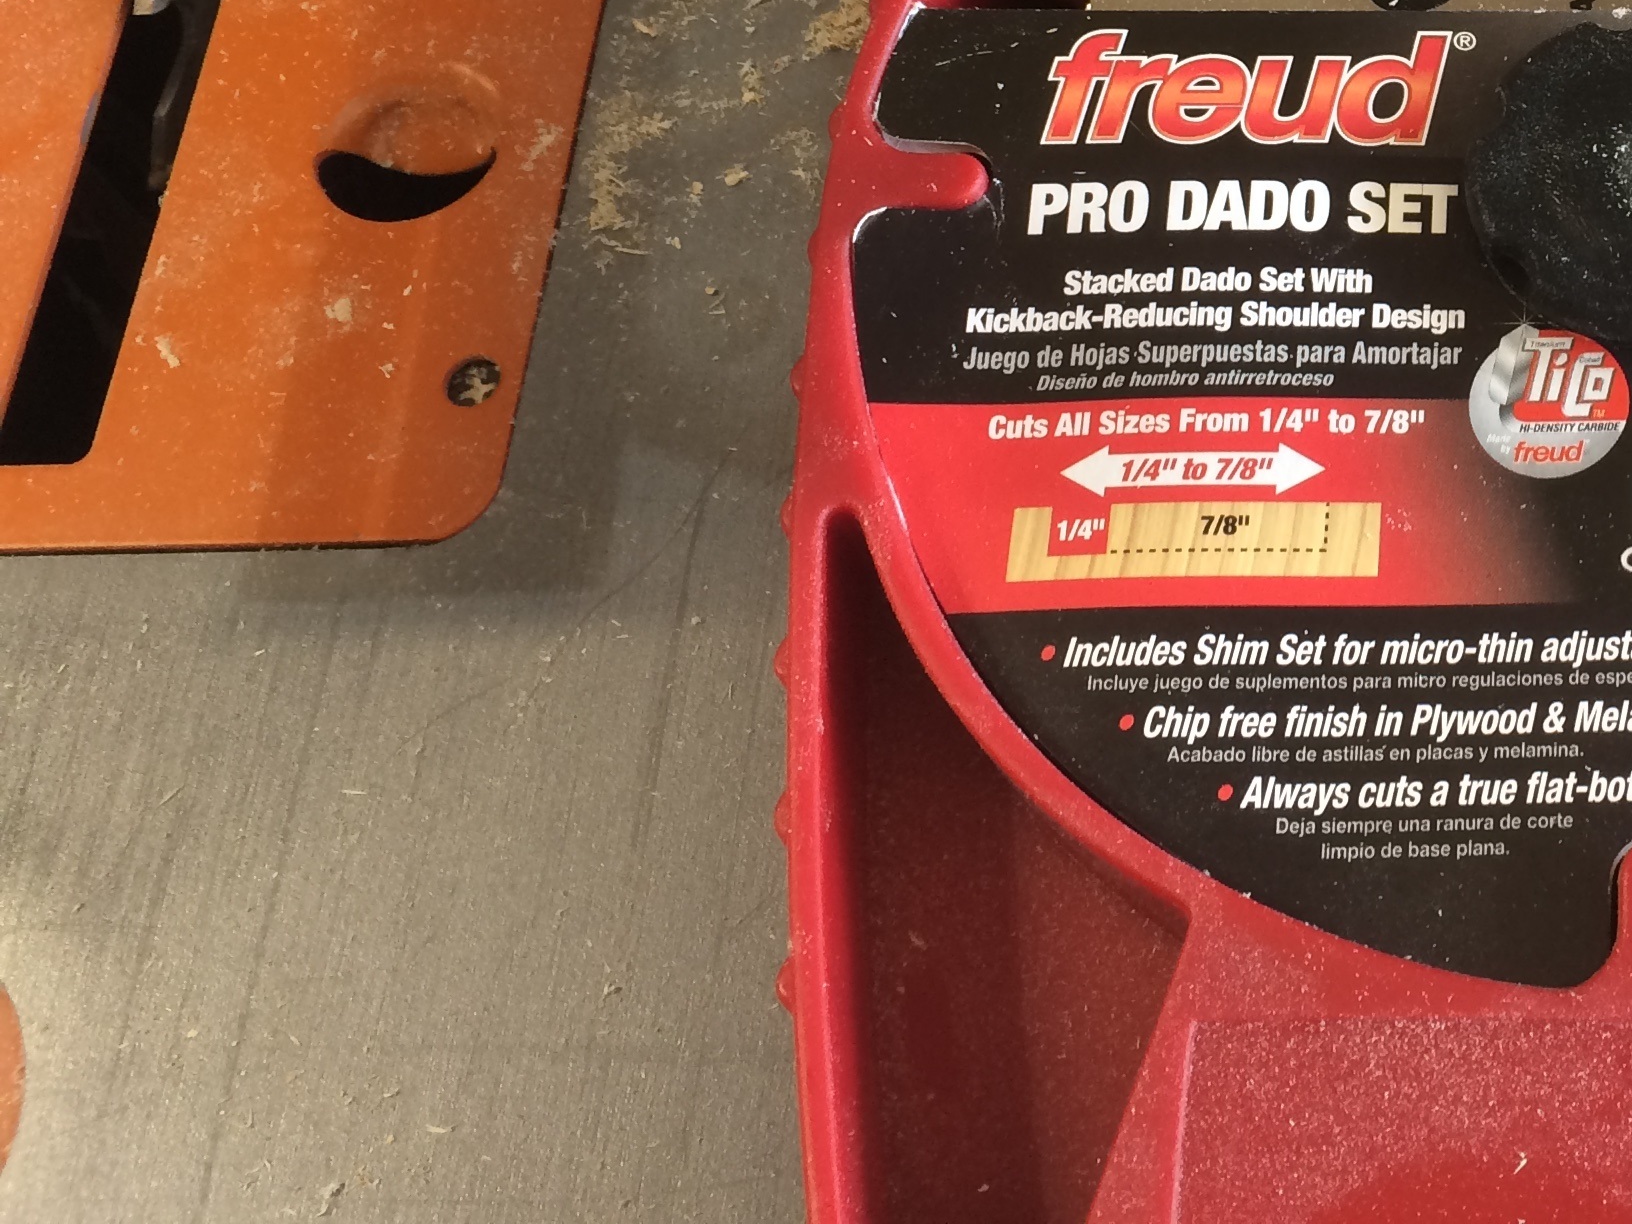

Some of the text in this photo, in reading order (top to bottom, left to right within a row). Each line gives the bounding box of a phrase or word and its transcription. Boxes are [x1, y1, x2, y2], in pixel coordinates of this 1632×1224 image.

[1027, 179, 1459, 236] PRO DADO SET
[1063, 267, 1373, 296] Stacked Dado Set With
[965, 301, 1466, 334] Kickback-Reducing Shoulder Design
[963, 339, 1463, 374] Juego de Hojas Superpuestas para Amortajar
[1036, 370, 1335, 391] Diseño de hombro antirretroceso
[988, 408, 1425, 441] Cuts All Sizes From 1/4" to 7/8"
[1519, 422, 1621, 433] HI-DENSITY CARBIDE
[1514, 439, 1585, 464] freud
[1121, 457, 1274, 483] 1/4" to 7/8"
[1057, 518, 1106, 542] 1/4"
[1200, 515, 1251, 537] 7/8"
[1063, 634, 1187, 668] Includes
[1194, 634, 1269, 666] Shim
[1276, 633, 1326, 666] Set
[1331, 633, 1375, 666] for
[1381, 633, 1534, 666] micro-thin
[1087, 674, 1149, 694] Incluye
[1153, 675, 1203, 694] juego
[1208, 674, 1230, 690] de
[1235, 674, 1348, 693] suplementos
[1352, 675, 1393, 692] para
[1398, 673, 1446, 689] micro
[1451, 671, 1564, 691] regulaciones
[1568, 670, 1590, 686] de
[1143, 706, 1211, 745] Chip
[1217, 706, 1277, 739] free
[1284, 705, 1368, 739] finish
[1374, 704, 1403, 738] in
[1410, 701, 1538, 742] Plywood
[1542, 701, 1566, 733] &
[1167, 742, 1584, 763] Acabado libre de astillas en placas y melamina.
[1240, 776, 1351, 815] Always
[1358, 775, 1423, 807] cuts
[1430, 781, 1448, 806] a
[1457, 774, 1518, 806] true
[1276, 813, 1573, 837] Deja siempre una ranura de corte
[1321, 840, 1510, 863] limpio de base plana.
